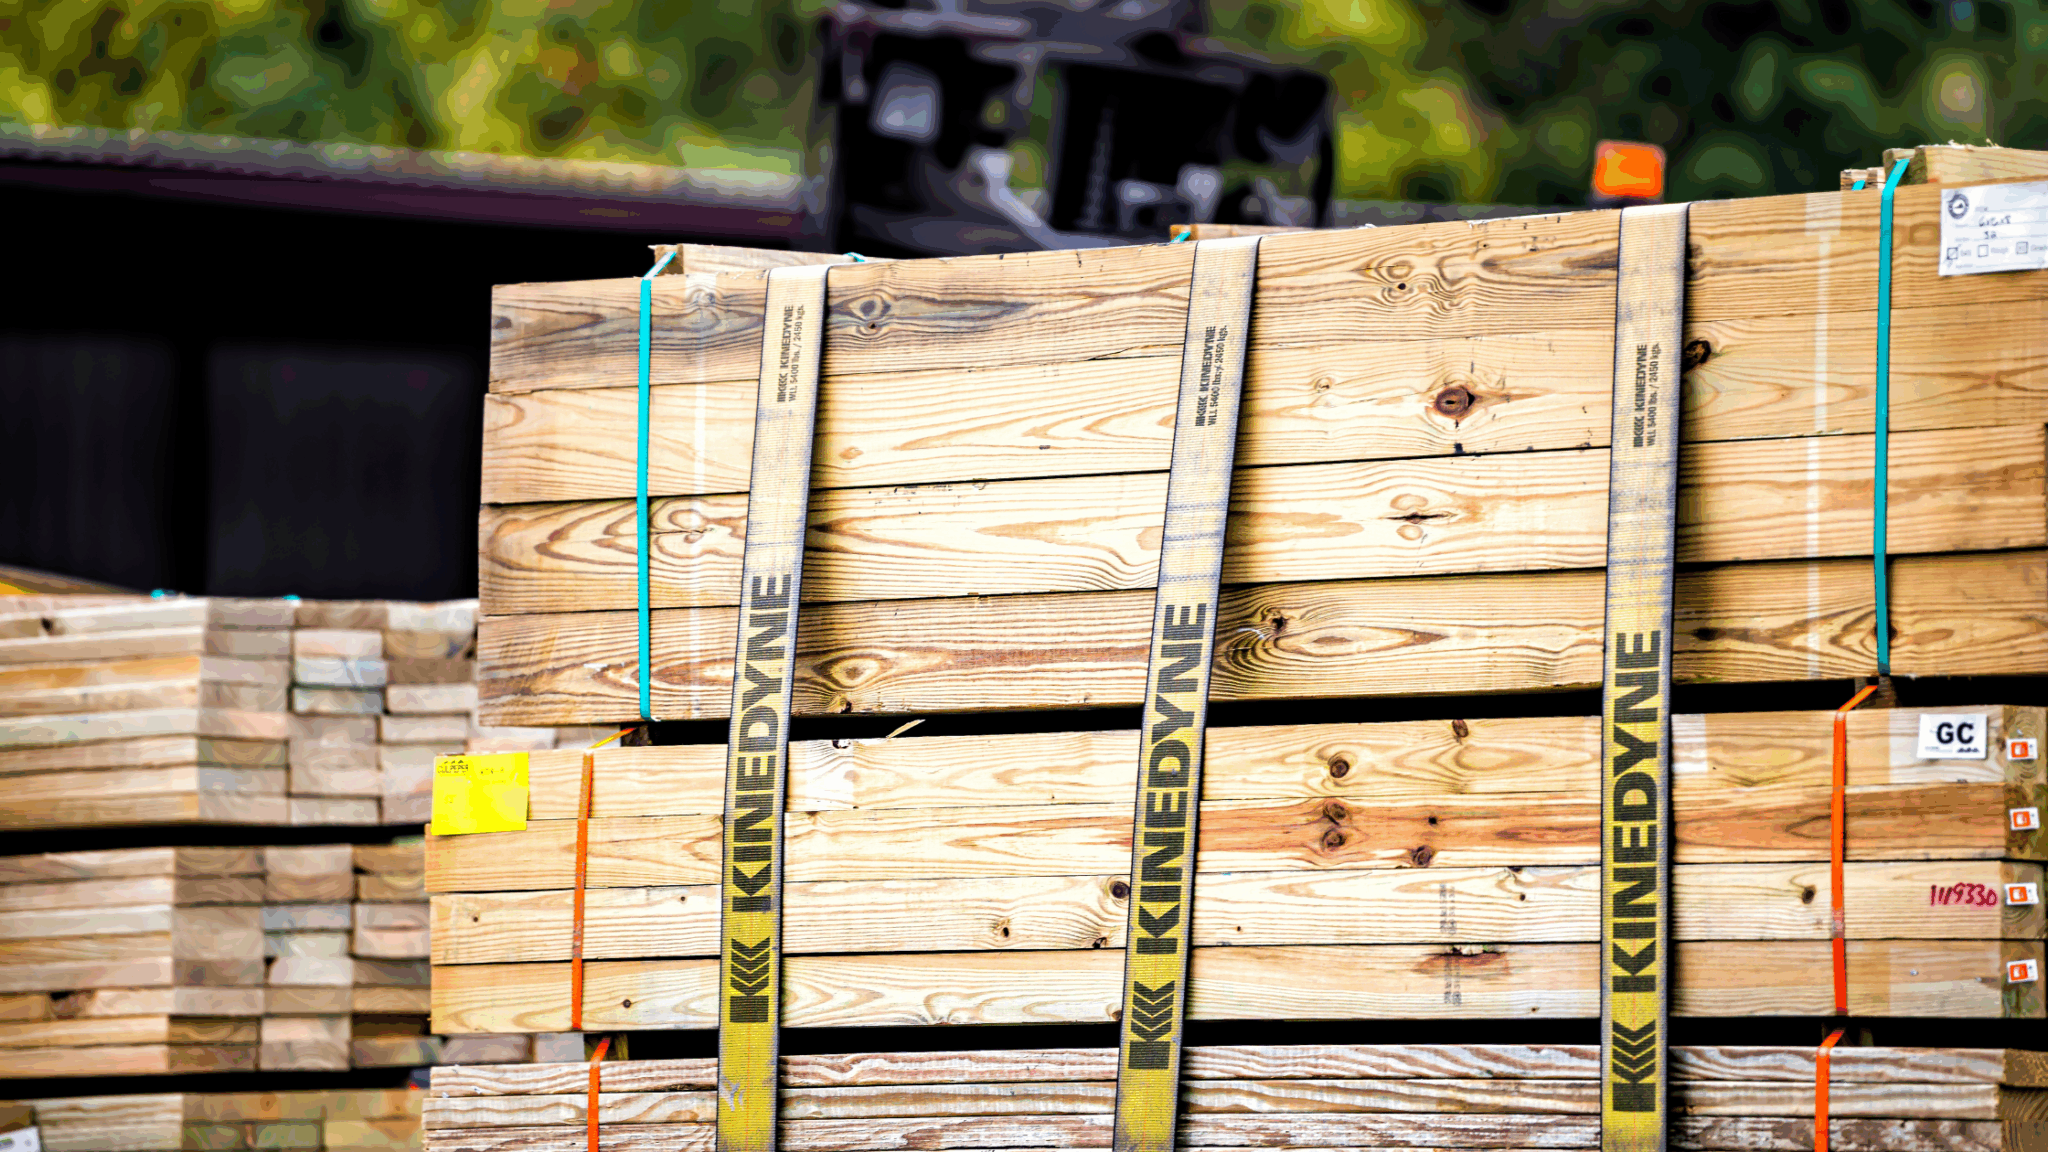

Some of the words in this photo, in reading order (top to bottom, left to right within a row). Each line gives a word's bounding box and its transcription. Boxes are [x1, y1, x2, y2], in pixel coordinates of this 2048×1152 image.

[780, 305, 793, 369] KINEDYNE
[793, 322, 803, 341] 2450
[1199, 326, 1216, 392] KINEDYNE
[1214, 343, 1225, 364] 2450
[789, 364, 799, 384] 5400
[1634, 344, 1647, 412] KINEDYNE
[1649, 361, 1659, 382] 2450
[1210, 386, 1220, 407] 5400
[1647, 406, 1657, 428] 5400
[1647, 429, 1656, 446] WLL
[732, 573, 791, 912] KINEDYNE
[1936, 721, 1974, 745] GC
[1136, 602, 1207, 955] KINEDYNE
[1612, 630, 1661, 993] KINEDYNE
[1930, 881, 1998, 907] 1119330
